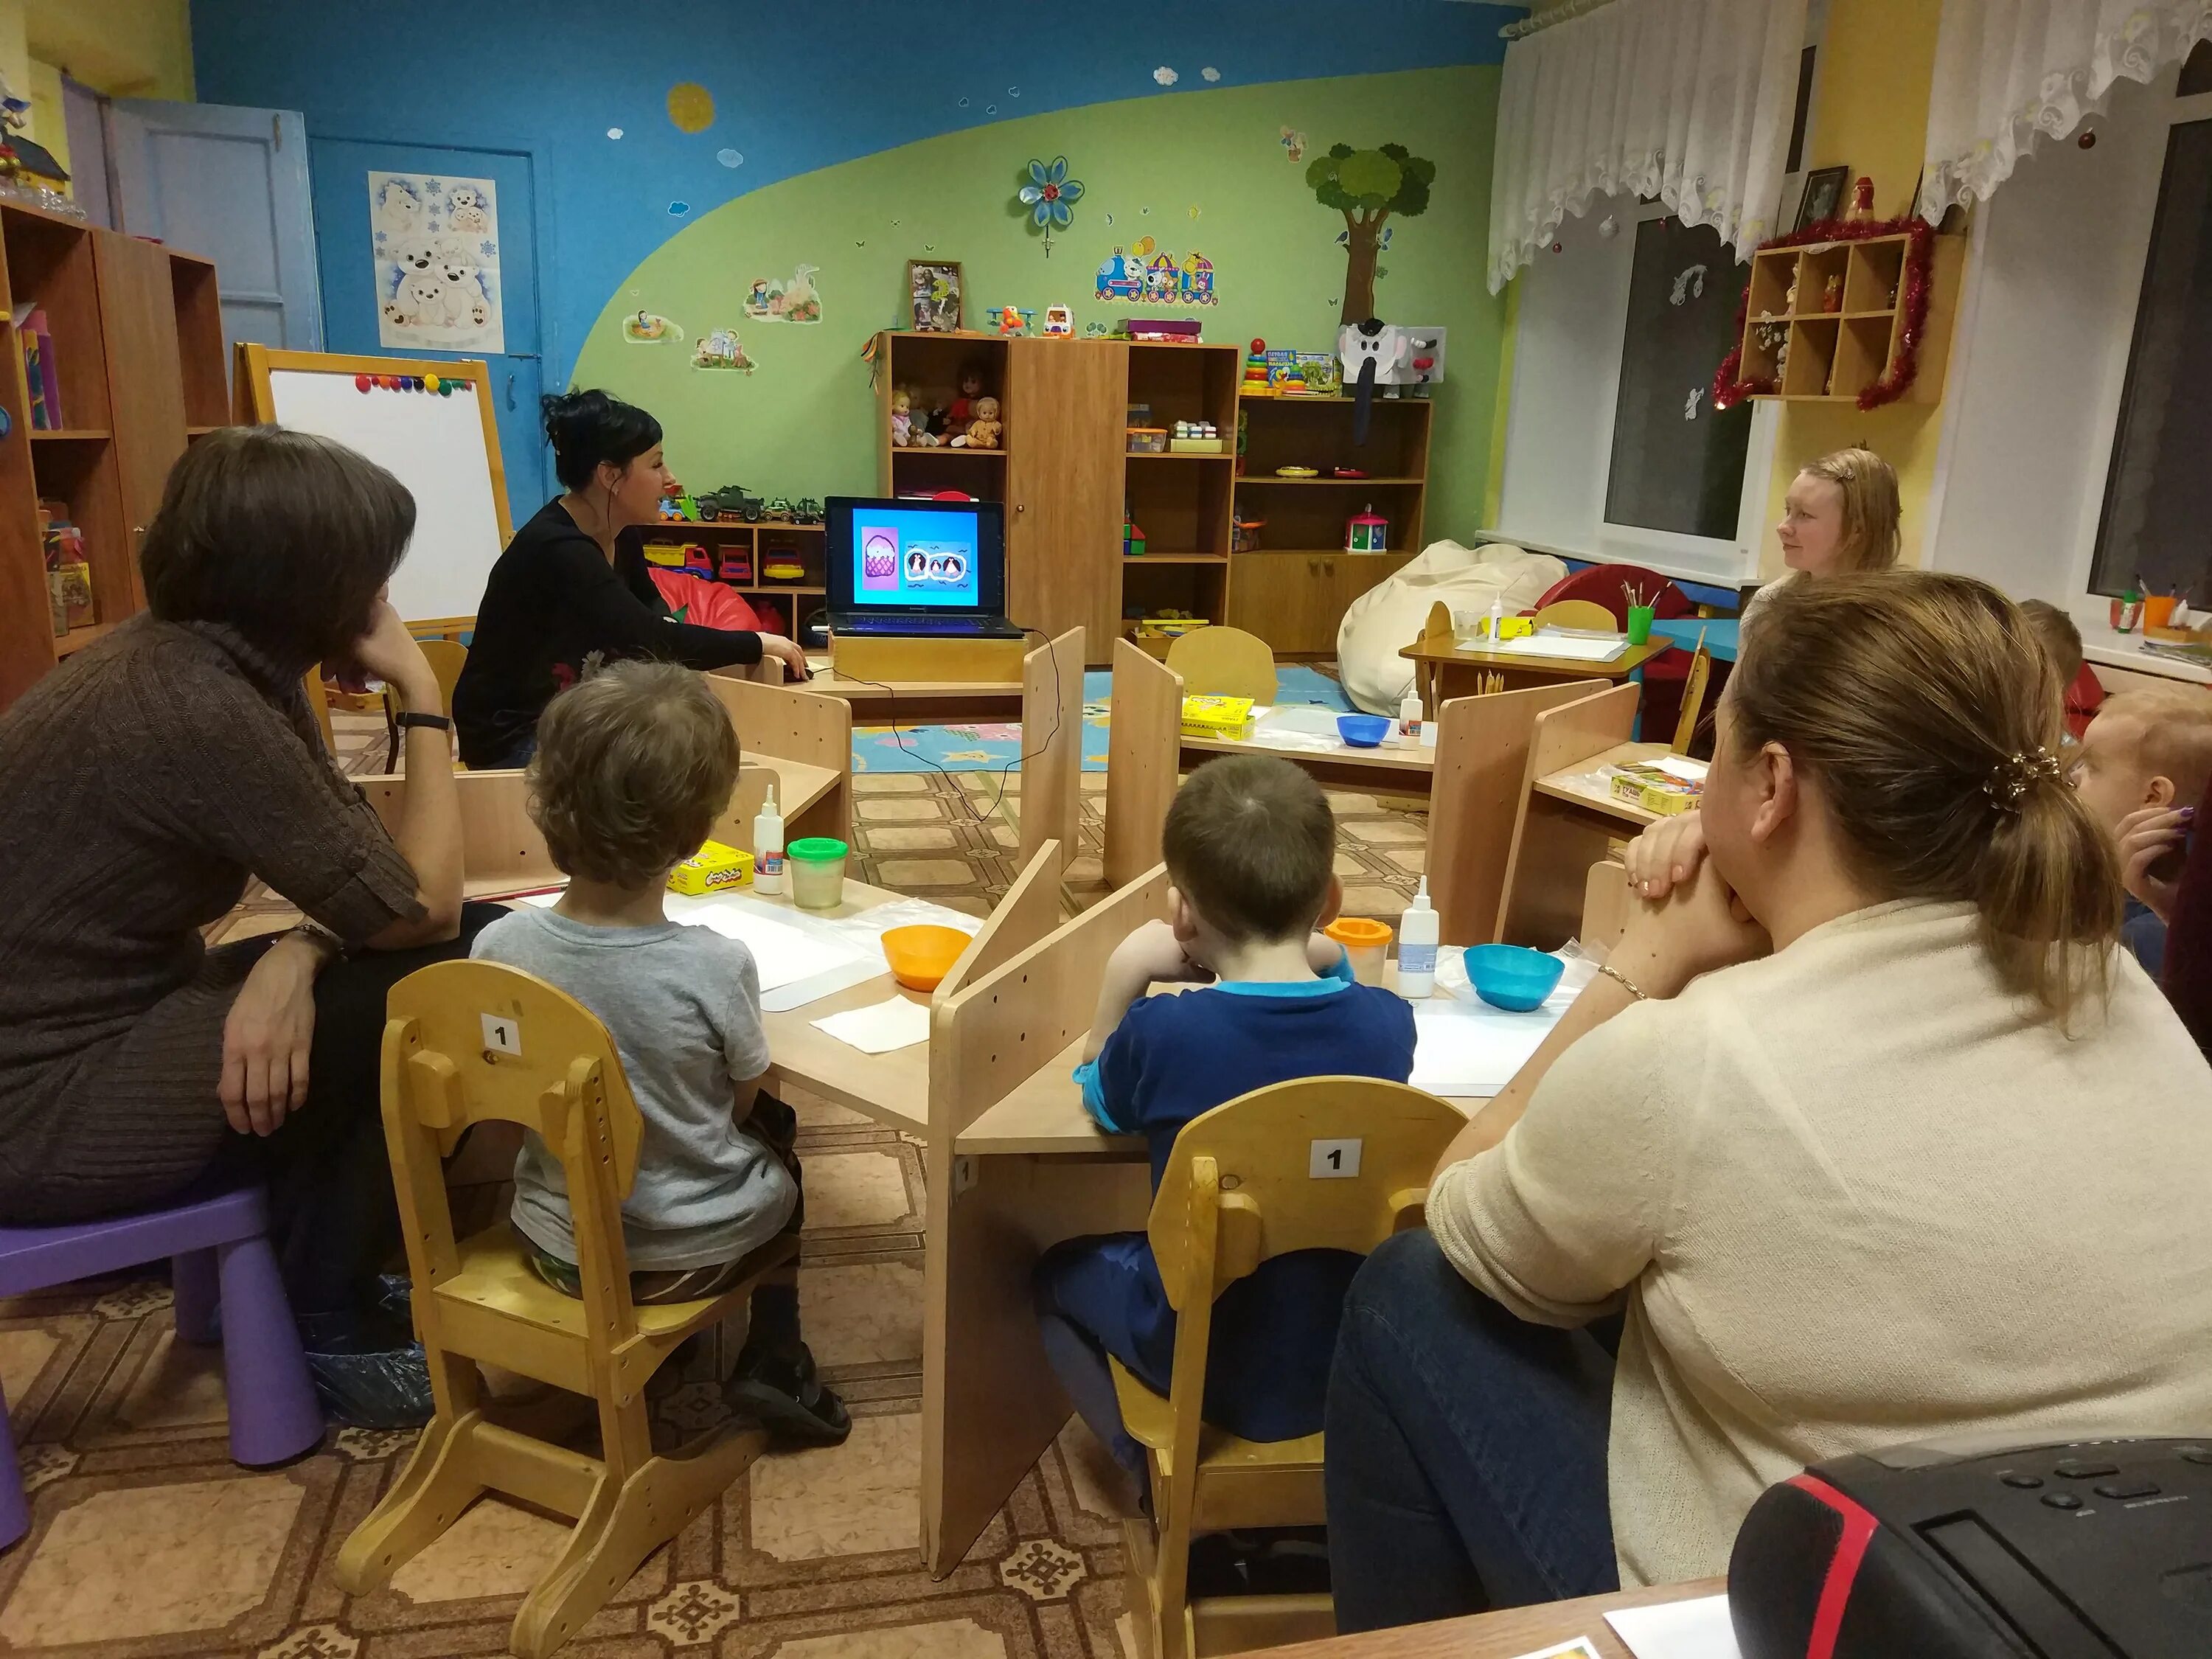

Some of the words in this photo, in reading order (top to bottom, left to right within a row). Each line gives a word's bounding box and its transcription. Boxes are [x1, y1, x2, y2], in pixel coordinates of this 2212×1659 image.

[495, 1026, 507, 1046] 1
[1327, 1150, 1341, 1170] 1
[962, 1161, 969, 1182] 1
